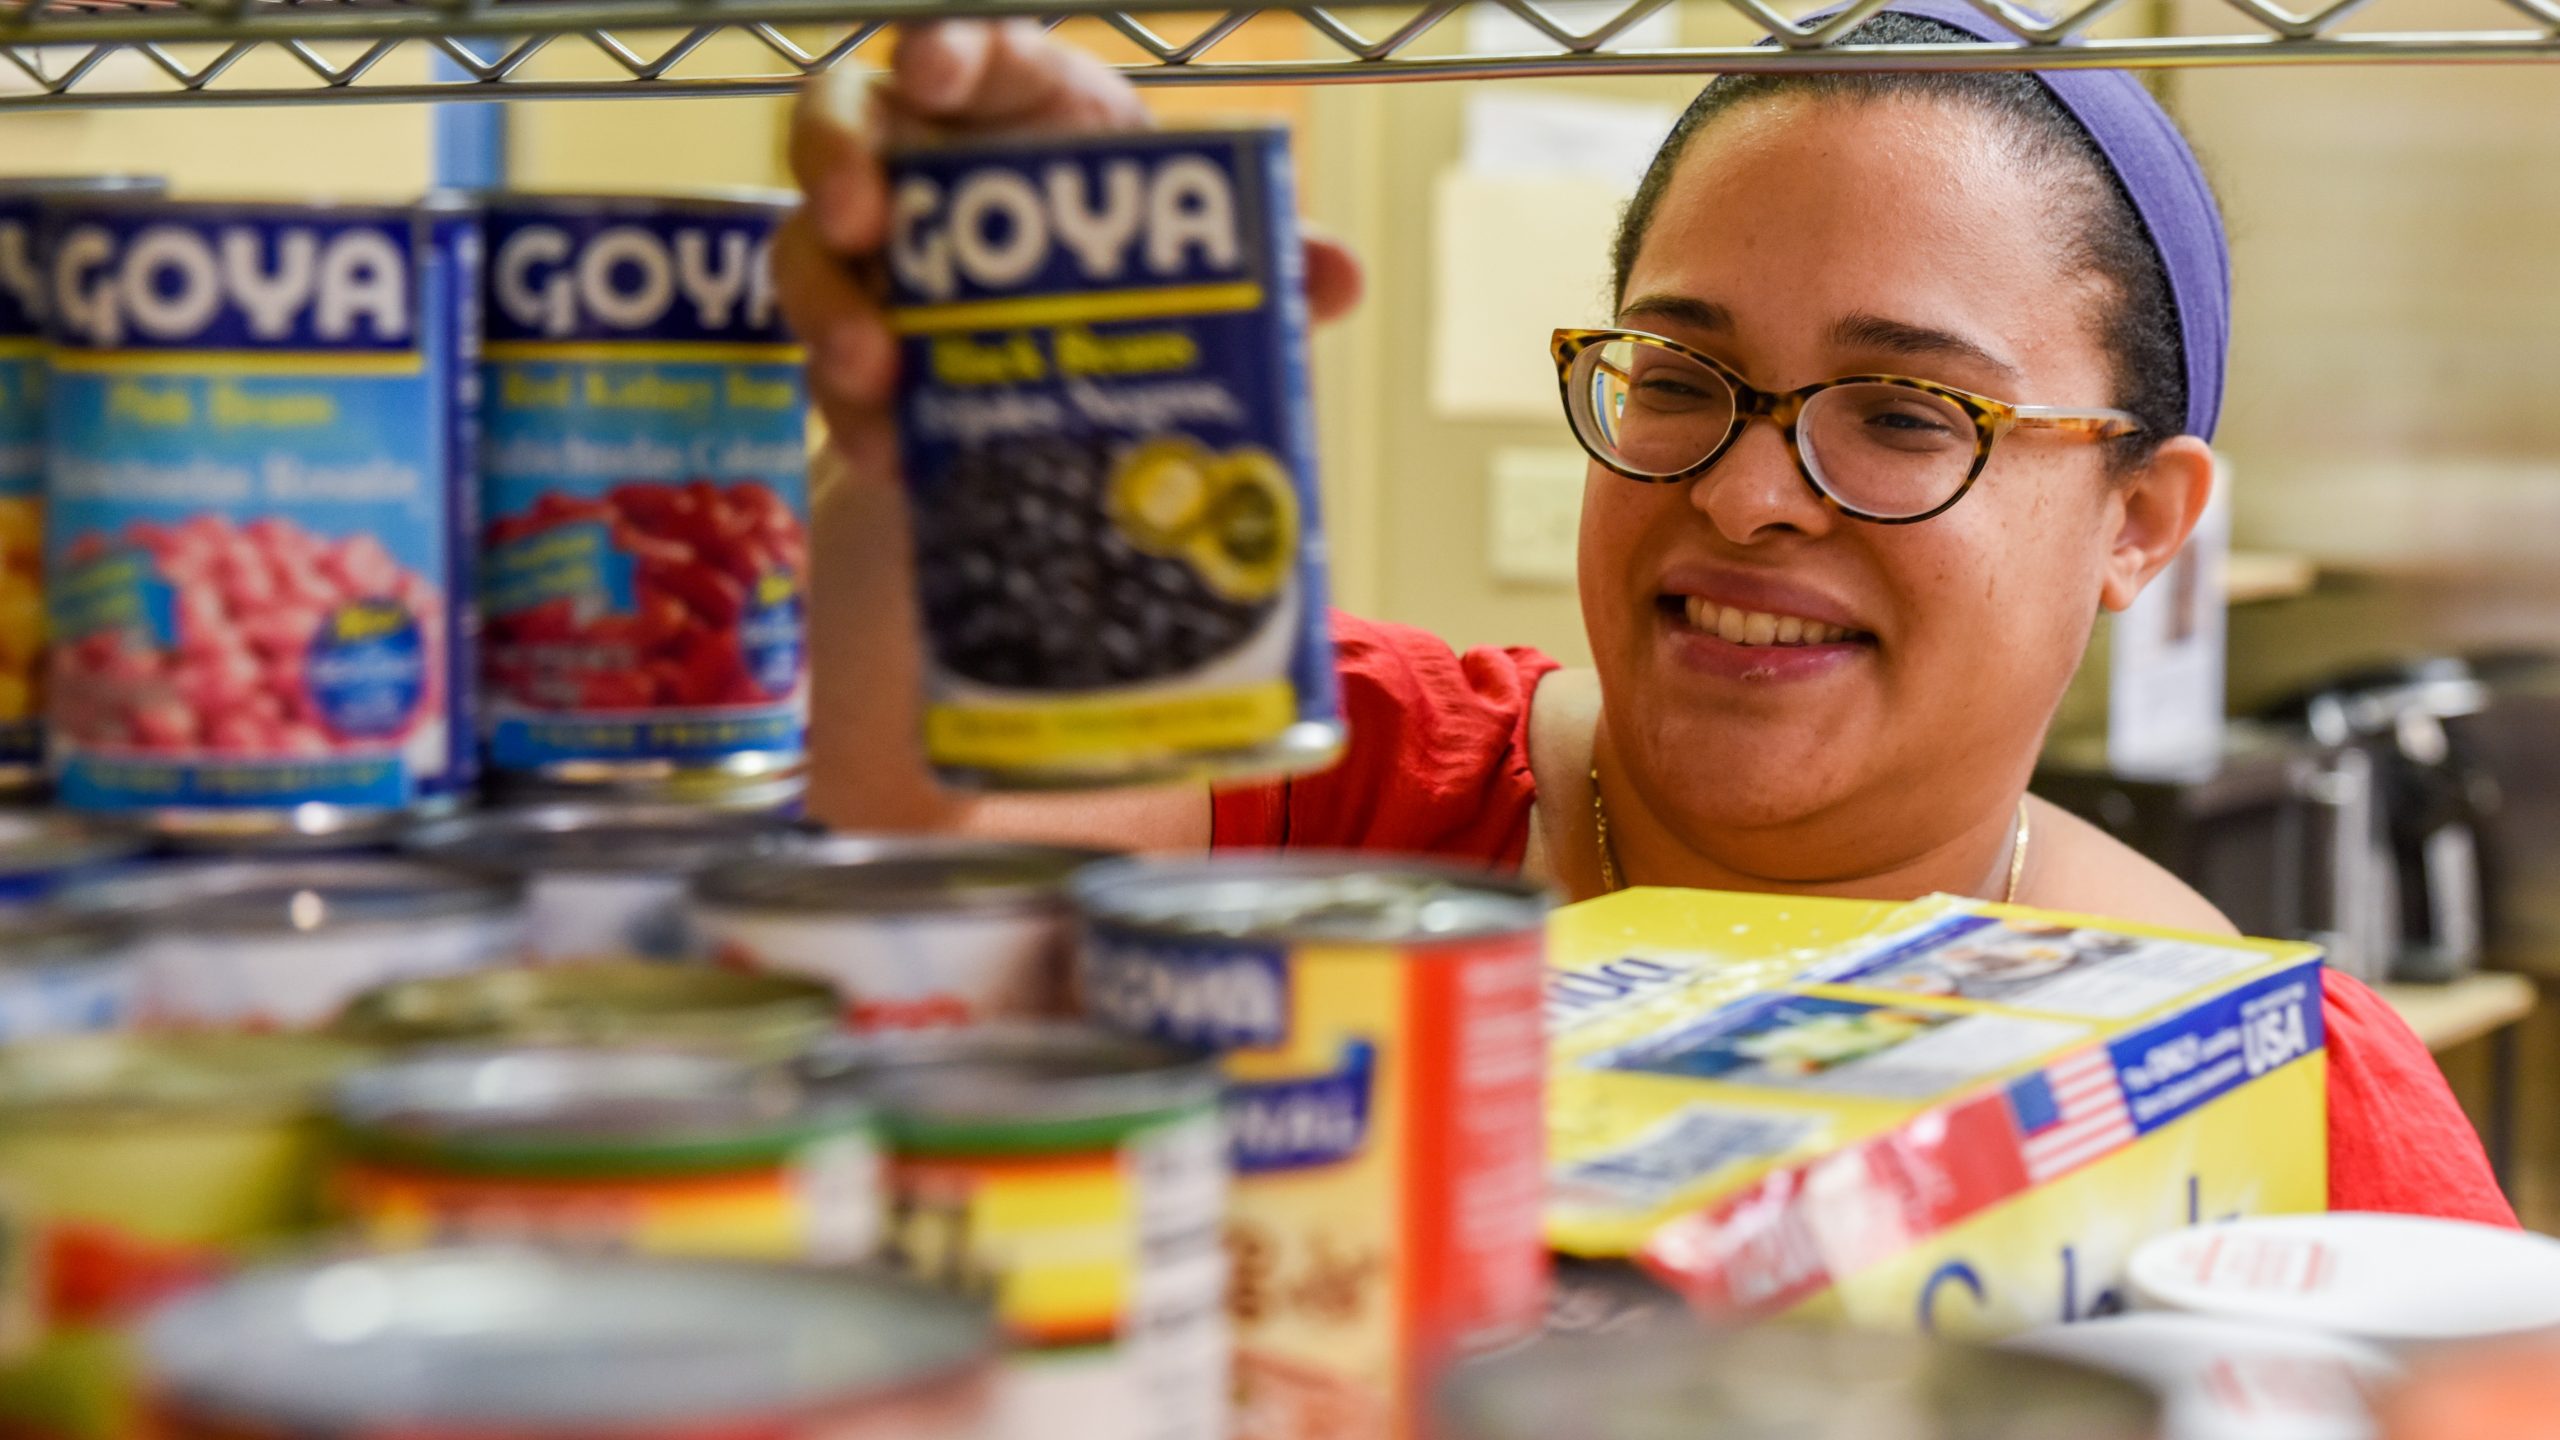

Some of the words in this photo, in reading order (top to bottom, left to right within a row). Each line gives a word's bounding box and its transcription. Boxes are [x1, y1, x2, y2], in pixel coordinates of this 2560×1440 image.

[55, 224, 412, 344] GOYA
[892, 153, 1238, 299] GOYA
[2243, 1001, 2308, 1077] USA
